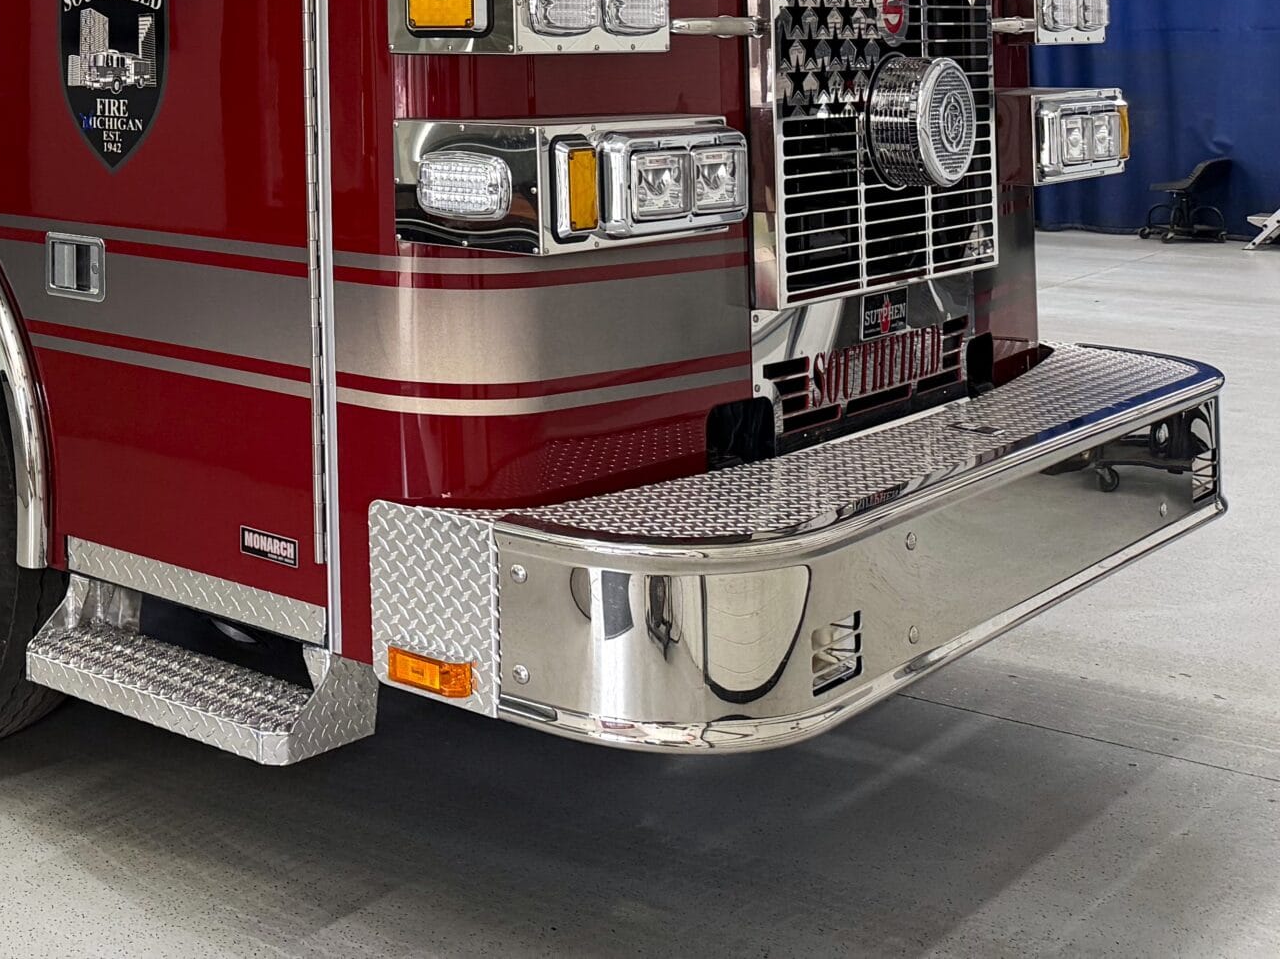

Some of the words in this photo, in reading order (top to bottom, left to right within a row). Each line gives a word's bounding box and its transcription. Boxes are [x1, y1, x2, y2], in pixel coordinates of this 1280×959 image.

[96, 98, 129, 117] FIRE
[81, 115, 143, 131] MICHIGAN
[103, 130, 123, 142] EST.
[103, 142, 122, 153] 1942
[864, 302, 906, 326] SUTPHEN
[813, 324, 942, 408] SOUTHFIELD
[244, 530, 295, 559] MONARCH
